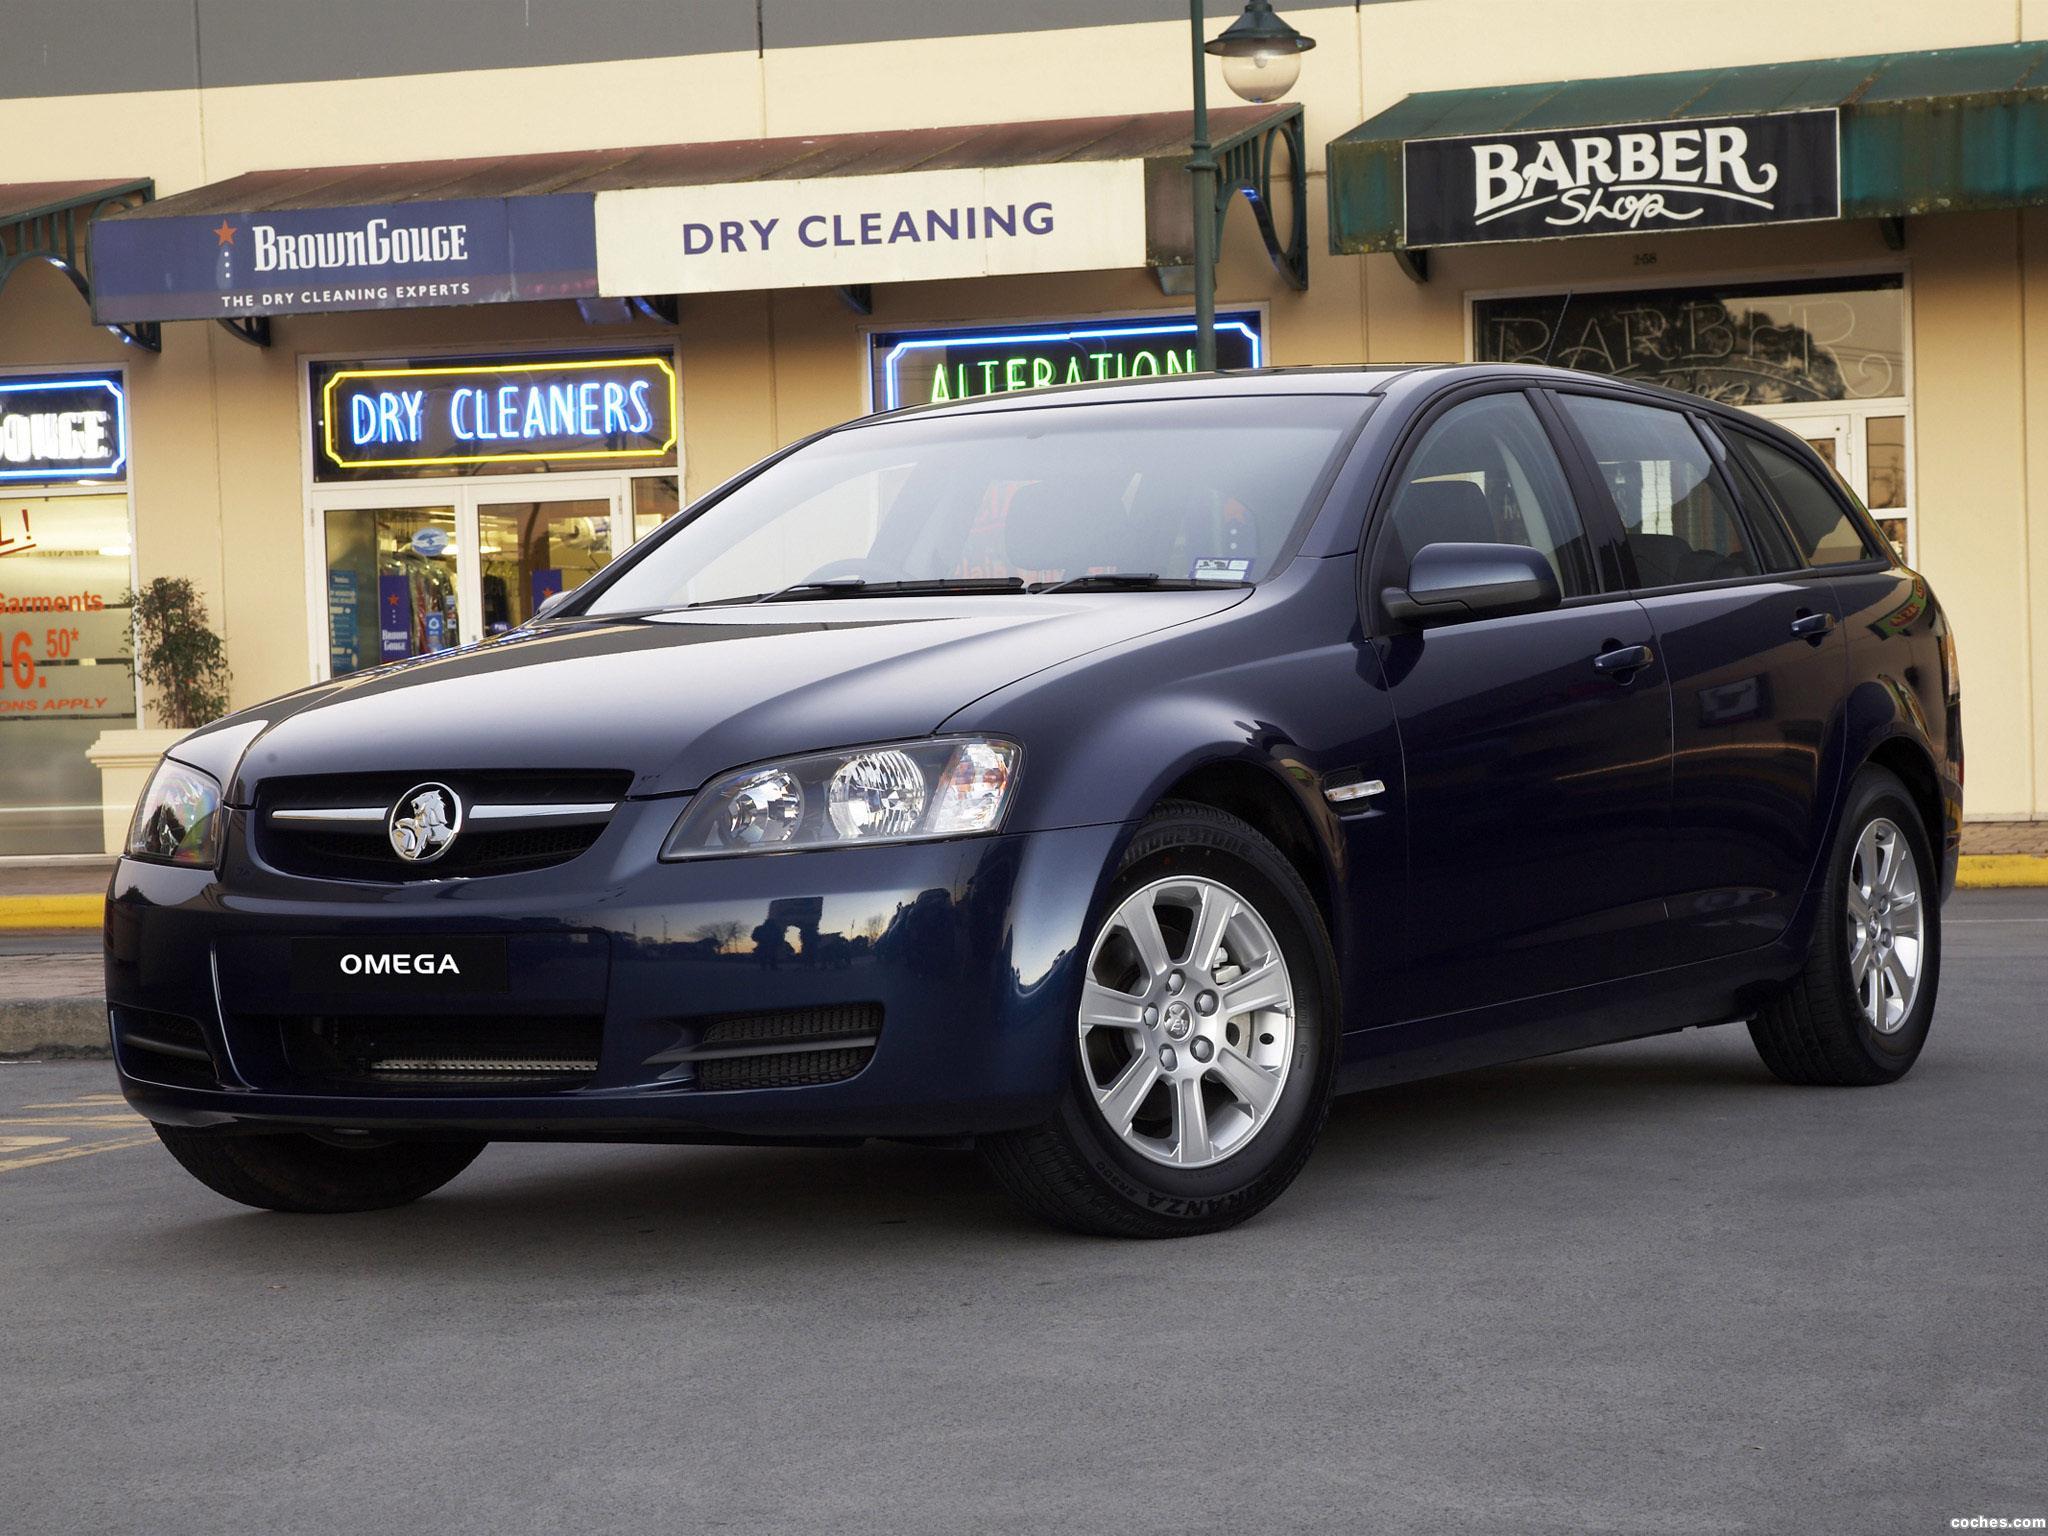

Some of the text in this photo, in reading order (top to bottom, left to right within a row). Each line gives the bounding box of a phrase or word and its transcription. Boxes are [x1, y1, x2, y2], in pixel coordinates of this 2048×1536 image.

[1471, 126, 1778, 217] BARBER
[683, 202, 1054, 255] DRY CLEANING
[1545, 187, 1704, 228] Shop
[222, 282, 470, 308] THE DRY CLEANING EXPERTS
[0, 410, 112, 462] OUGE
[352, 380, 651, 446] DRY CLEANERS
[43, 697, 108, 711] APPLY
[340, 953, 461, 975] OMEGA
